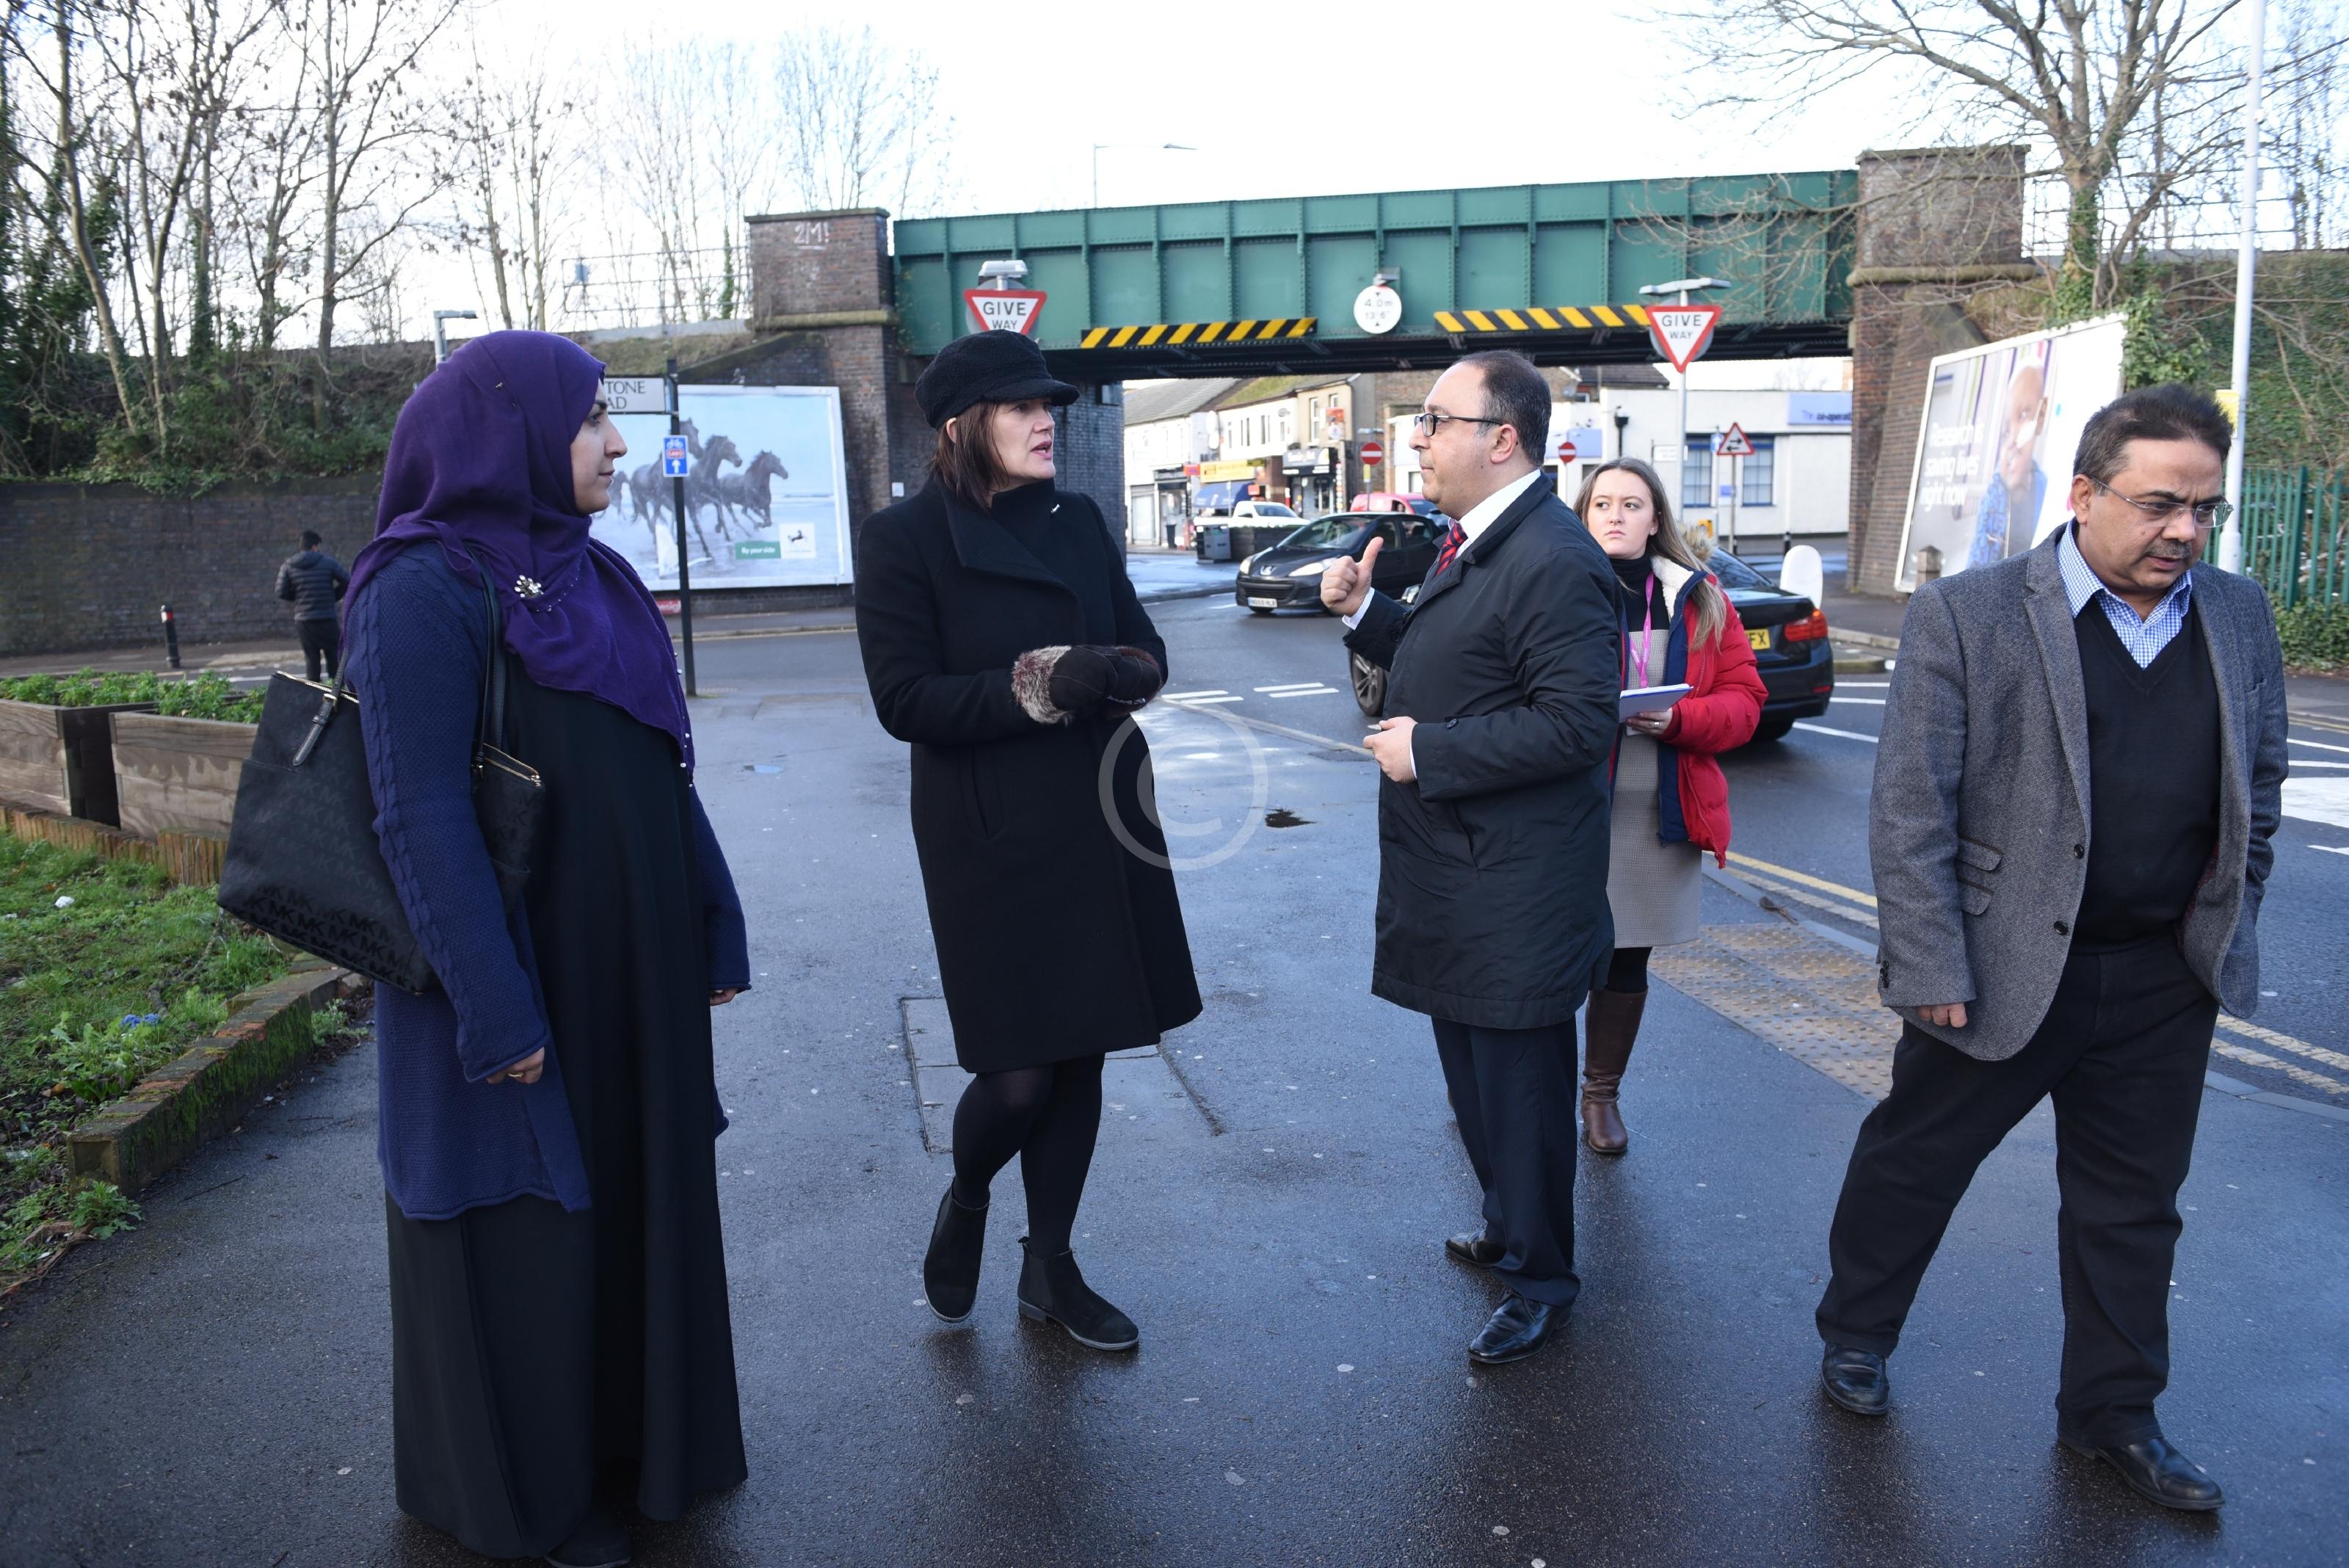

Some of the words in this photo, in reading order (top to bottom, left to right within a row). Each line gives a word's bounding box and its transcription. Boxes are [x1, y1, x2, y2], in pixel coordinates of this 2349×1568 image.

[983, 302, 1026, 316] GIVE
[992, 320, 1017, 330] WAY
[1662, 314, 1702, 327] GIVE
[1929, 421, 1974, 447] Research
[1974, 419, 1985, 444] is
[1925, 451, 1956, 482] saving
[1956, 450, 1981, 476] lives
[1919, 481, 1945, 512] right
[1945, 485, 1968, 506] now
[741, 547, 749, 555] By
